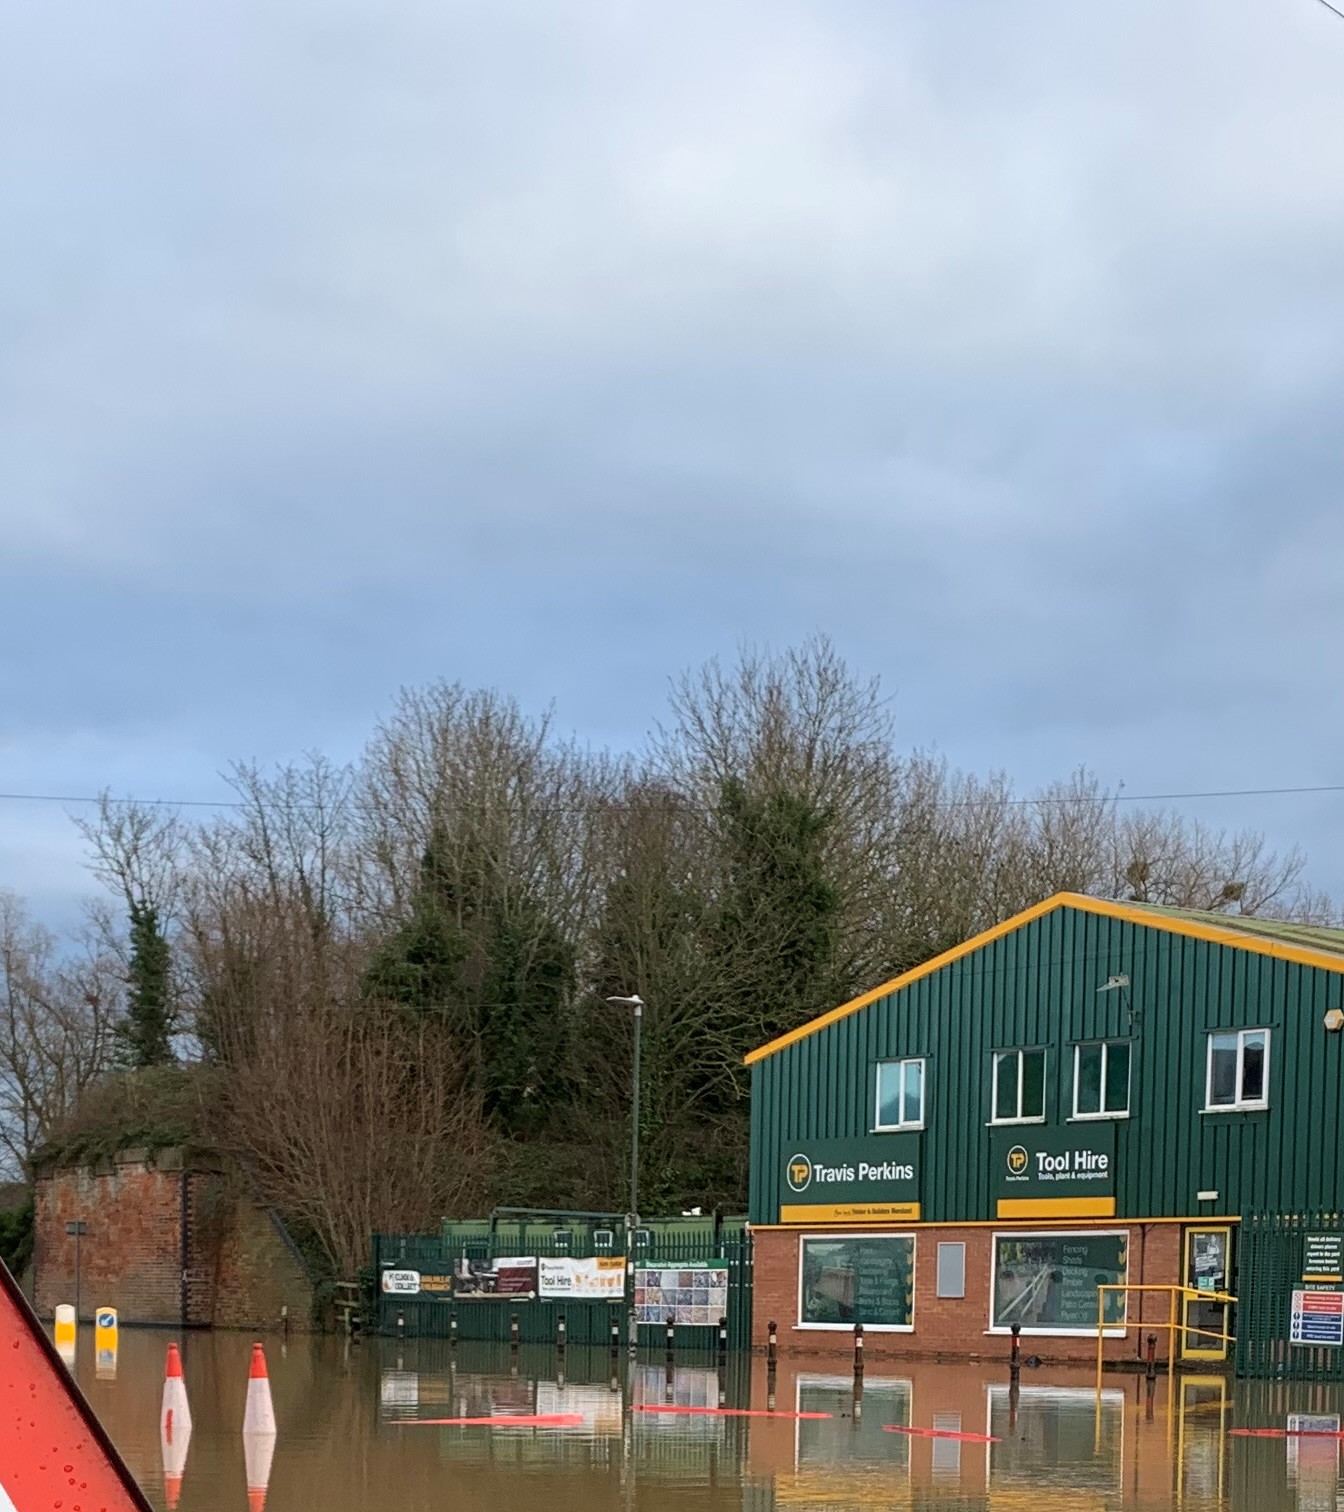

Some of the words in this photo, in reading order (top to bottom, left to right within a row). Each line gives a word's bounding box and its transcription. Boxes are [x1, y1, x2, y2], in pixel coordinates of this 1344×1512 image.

[1036, 1151, 1070, 1171] Tool
[1074, 1150, 1109, 1170] Hire
[790, 1164, 809, 1183] TP
[813, 1163, 855, 1182] Travis
[858, 1161, 914, 1181] Perkins
[1056, 1171, 1070, 1181] plant
[1071, 1171, 1076, 1179] &
[1077, 1171, 1109, 1180] equipment
[541, 1275, 555, 1286] Tool
[557, 1275, 572, 1286] Hire
